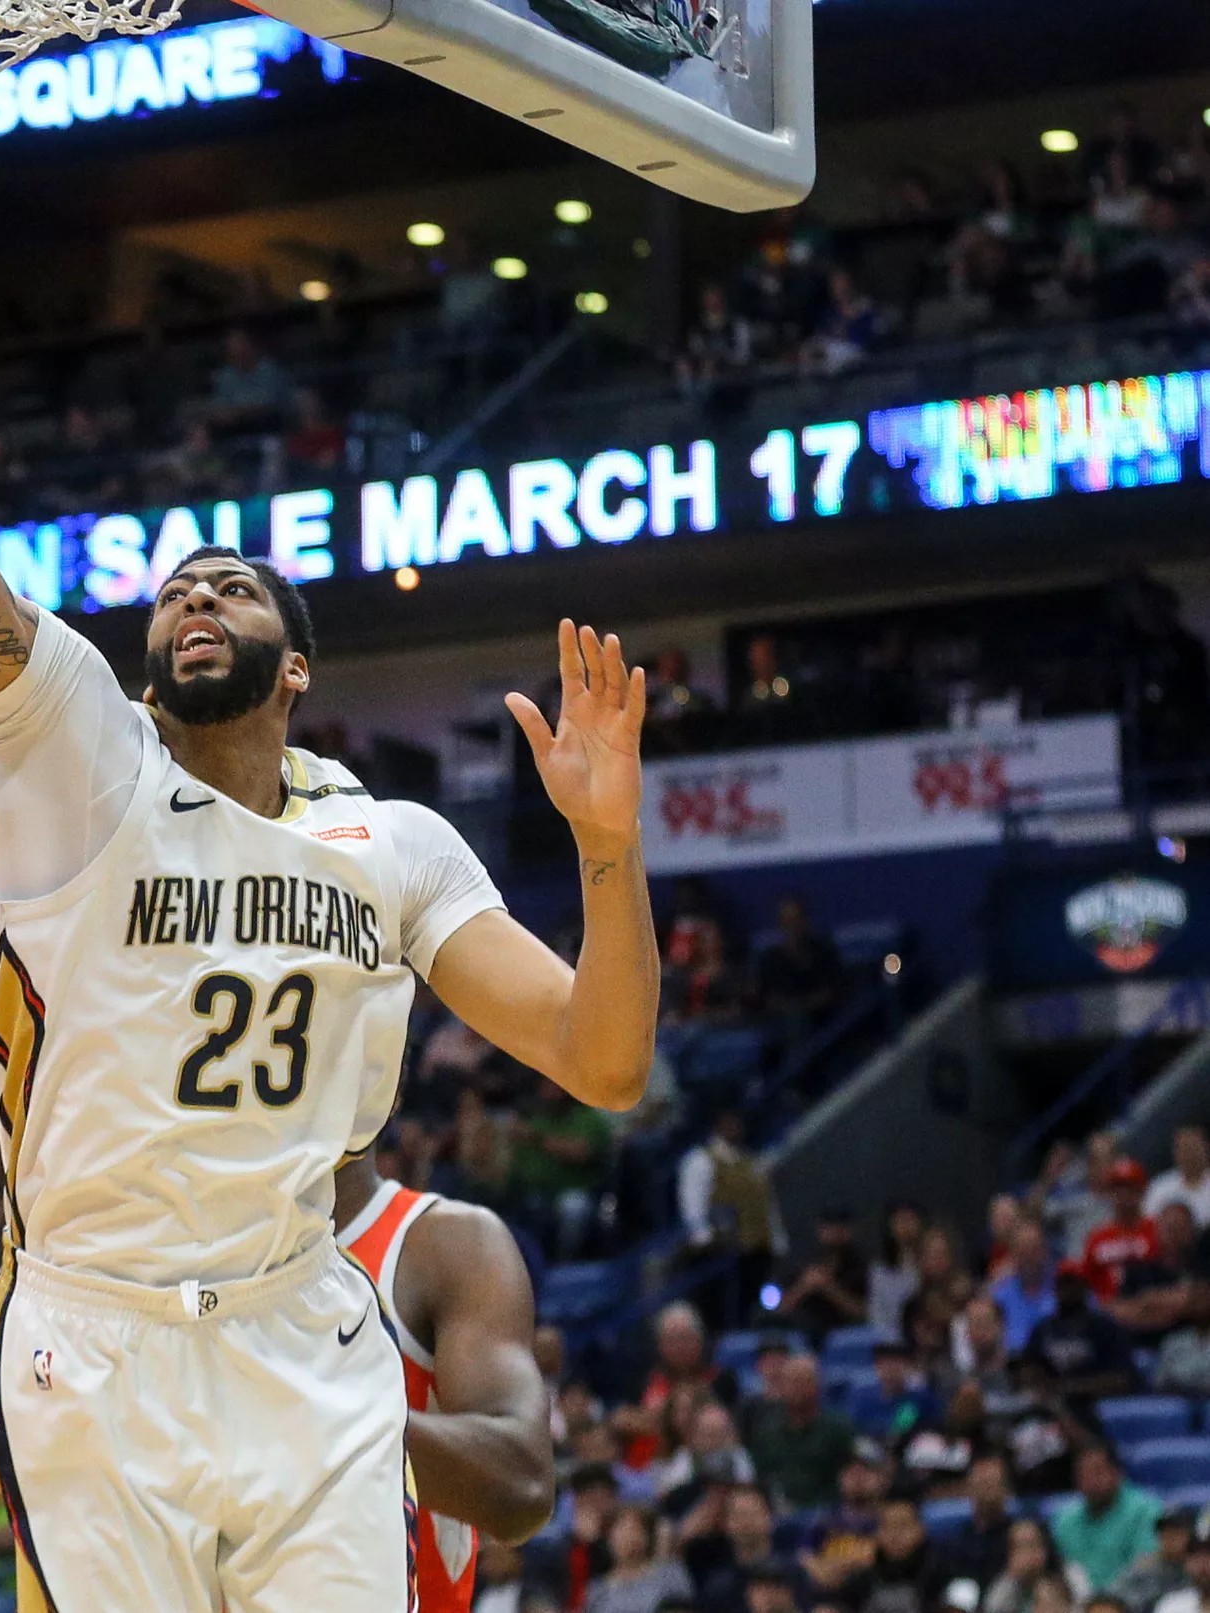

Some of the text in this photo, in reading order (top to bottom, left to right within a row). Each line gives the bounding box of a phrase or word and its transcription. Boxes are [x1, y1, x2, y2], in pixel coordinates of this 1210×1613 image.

[84, 488, 333, 607] SALE
[361, 438, 718, 574] MARCH
[750, 419, 861, 523] 17
[124, 875, 382, 972] NEW ORLEANS
[175, 970, 317, 1110] 23
